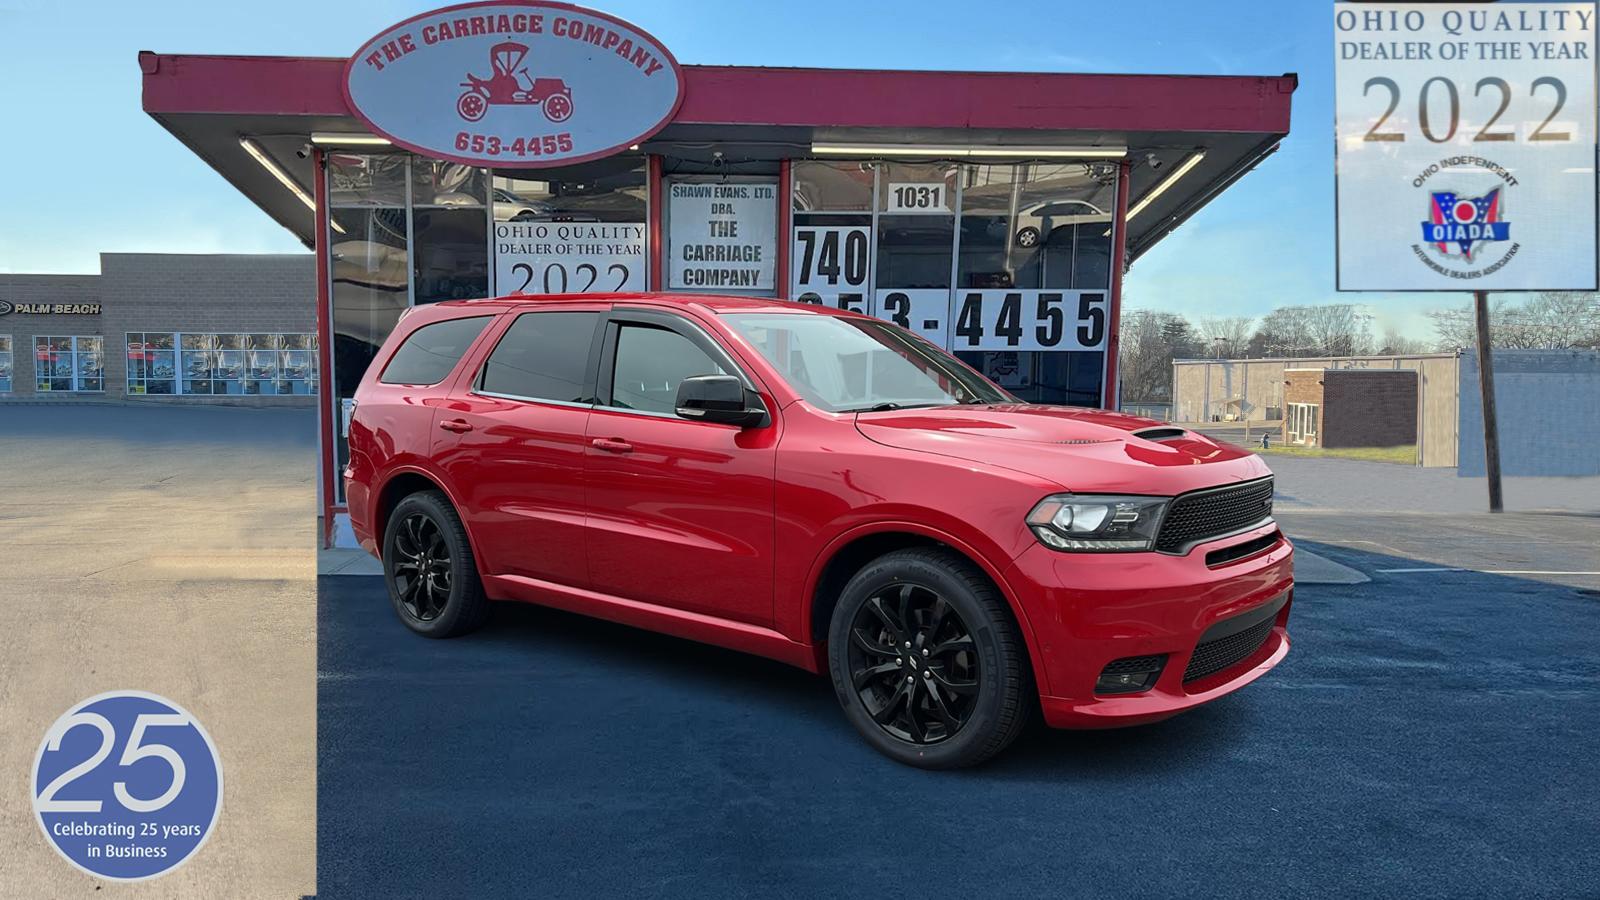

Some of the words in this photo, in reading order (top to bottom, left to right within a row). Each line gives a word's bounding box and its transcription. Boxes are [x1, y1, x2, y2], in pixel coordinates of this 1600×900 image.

[1336, 10, 1425, 31] OHIO
[1442, 10, 1592, 36] QUALITY
[365, 32, 417, 72] THE
[422, 14, 544, 46] CARRIAGE
[552, 16, 664, 78] COMPANY
[1340, 42, 1433, 60] DEALER
[1438, 42, 1469, 60] OF
[1475, 42, 1521, 60] THE
[1528, 41, 1589, 60] YEAR
[1363, 76, 1570, 143] 2022
[454, 131, 574, 157] 653-4455
[1412, 163, 1439, 188] OHIO
[1439, 155, 1519, 188] INDEPENDENT
[672, 186, 712, 199] SHAWN
[754, 187, 775, 200] LTD.
[894, 187, 940, 208] 1031
[711, 203, 735, 215] DBA.
[497, 226, 548, 239] OHIO
[557, 226, 644, 241] QUALITY
[708, 221, 738, 238] THE
[1432, 224, 1495, 240] OIADA
[499, 243, 552, 255] DEALER
[555, 243, 573, 255] OF
[576, 243, 603, 255] THE
[606, 243, 641, 255] YEAR
[683, 244, 762, 262] CARRIAGE
[797, 230, 868, 286] 740
[1450, 270, 1482, 280] DEALERS
[1483, 242, 1521, 277] ASSOCIATION
[511, 263, 629, 294] 2022
[683, 268, 760, 286] COMPANY
[14, 304, 50, 314] PALM
[54, 304, 100, 314] BEACH
